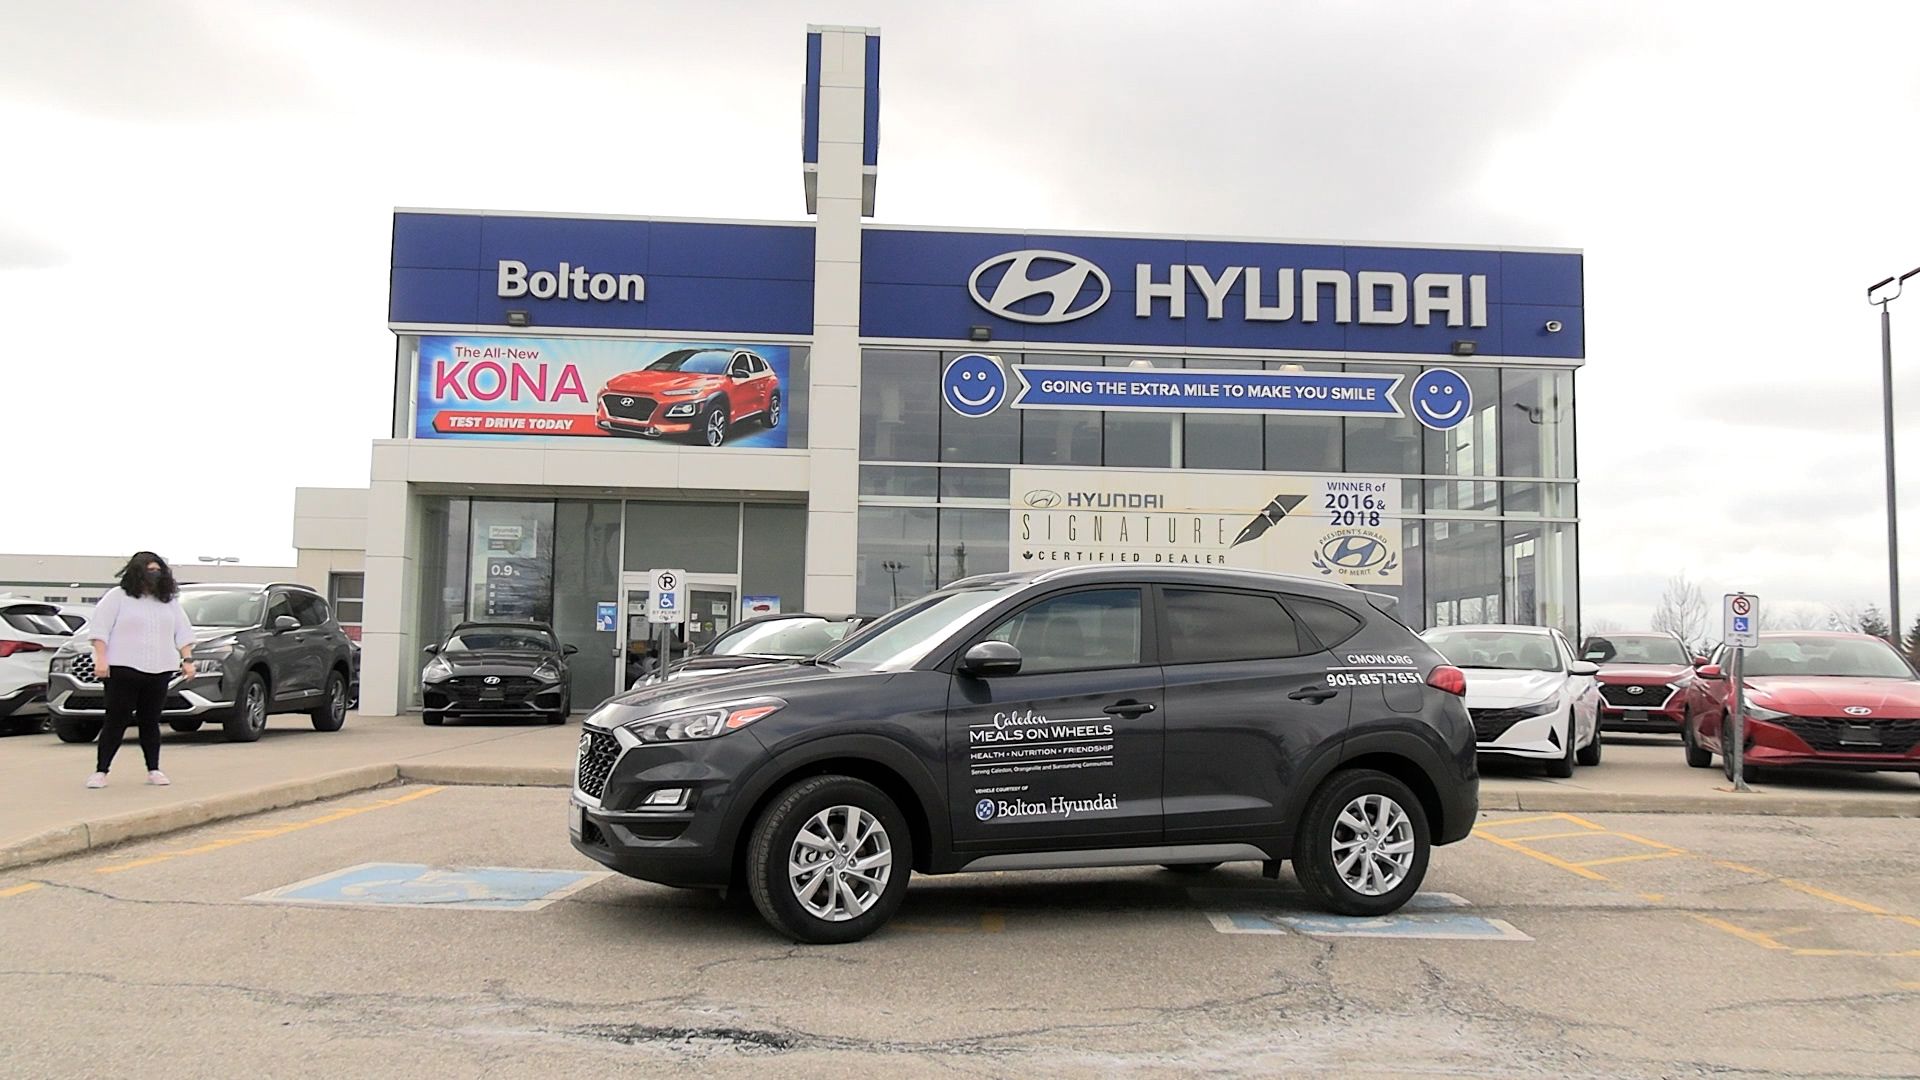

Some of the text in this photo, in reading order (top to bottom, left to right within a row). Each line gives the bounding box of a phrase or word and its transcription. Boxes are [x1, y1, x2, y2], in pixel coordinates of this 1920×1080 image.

[497, 259, 646, 302] Bolton
[1135, 263, 1488, 328] HYUNDAI
[455, 346, 539, 360] The All-New
[435, 360, 589, 403] KONA
[1041, 380, 1376, 401] GOING THE EXTRA MILE TO MAKE YOU SMILE
[449, 416, 574, 431] TEST DRIVE TODAY
[1327, 482, 1386, 492] WINNER of
[1067, 492, 1164, 509] HYUNDAI
[1325, 493, 1386, 510] 2016 &
[1330, 510, 1381, 527] 2018
[1022, 513, 1225, 545] SIGNATURE
[1319, 528, 1388, 545] PRESIDENT'S AWARD
[1038, 551, 1226, 564] CERTIFIED DEALER
[1349, 568, 1371, 576] MERIT
[1347, 654, 1414, 665] CMOW.ORG
[1326, 672, 1425, 687] 905.857.7651
[993, 710, 1048, 730] Caledon
[969, 724, 1114, 743] MEALS ON WHEELS
[970, 744, 1114, 760] HEALTH NUTRITION FRIENDSHIP
[997, 793, 1118, 818] Bolton Hyundai
